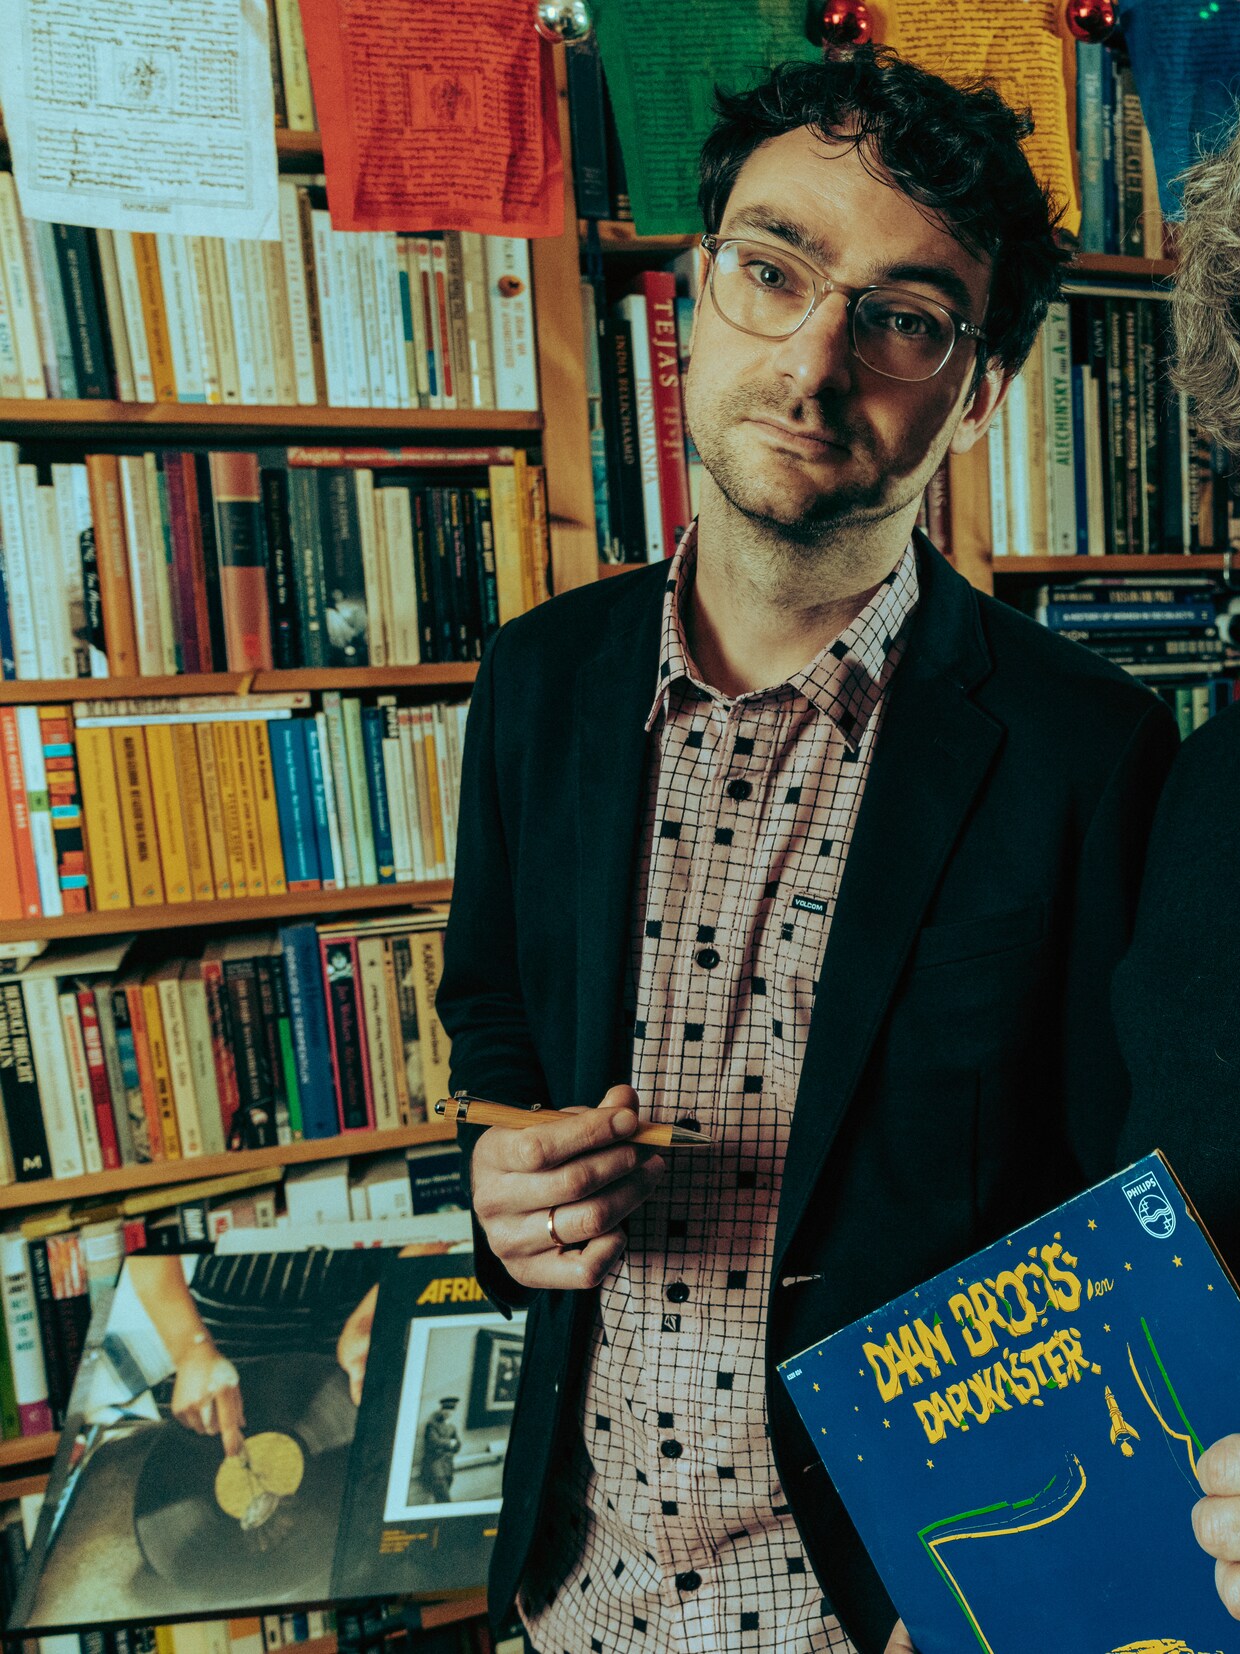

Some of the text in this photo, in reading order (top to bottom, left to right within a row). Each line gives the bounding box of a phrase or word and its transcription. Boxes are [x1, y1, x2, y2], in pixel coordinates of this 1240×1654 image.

[614, 335, 630, 374] INDIA
[652, 299, 679, 389] TEJAS
[636, 378, 659, 485] INDOMANIA
[1053, 377, 1071, 466] ALECHINSKY
[795, 898, 823, 911] VOLCOM
[1126, 1177, 1157, 1200] PHILIPS
[862, 1311, 958, 1403] DAAN
